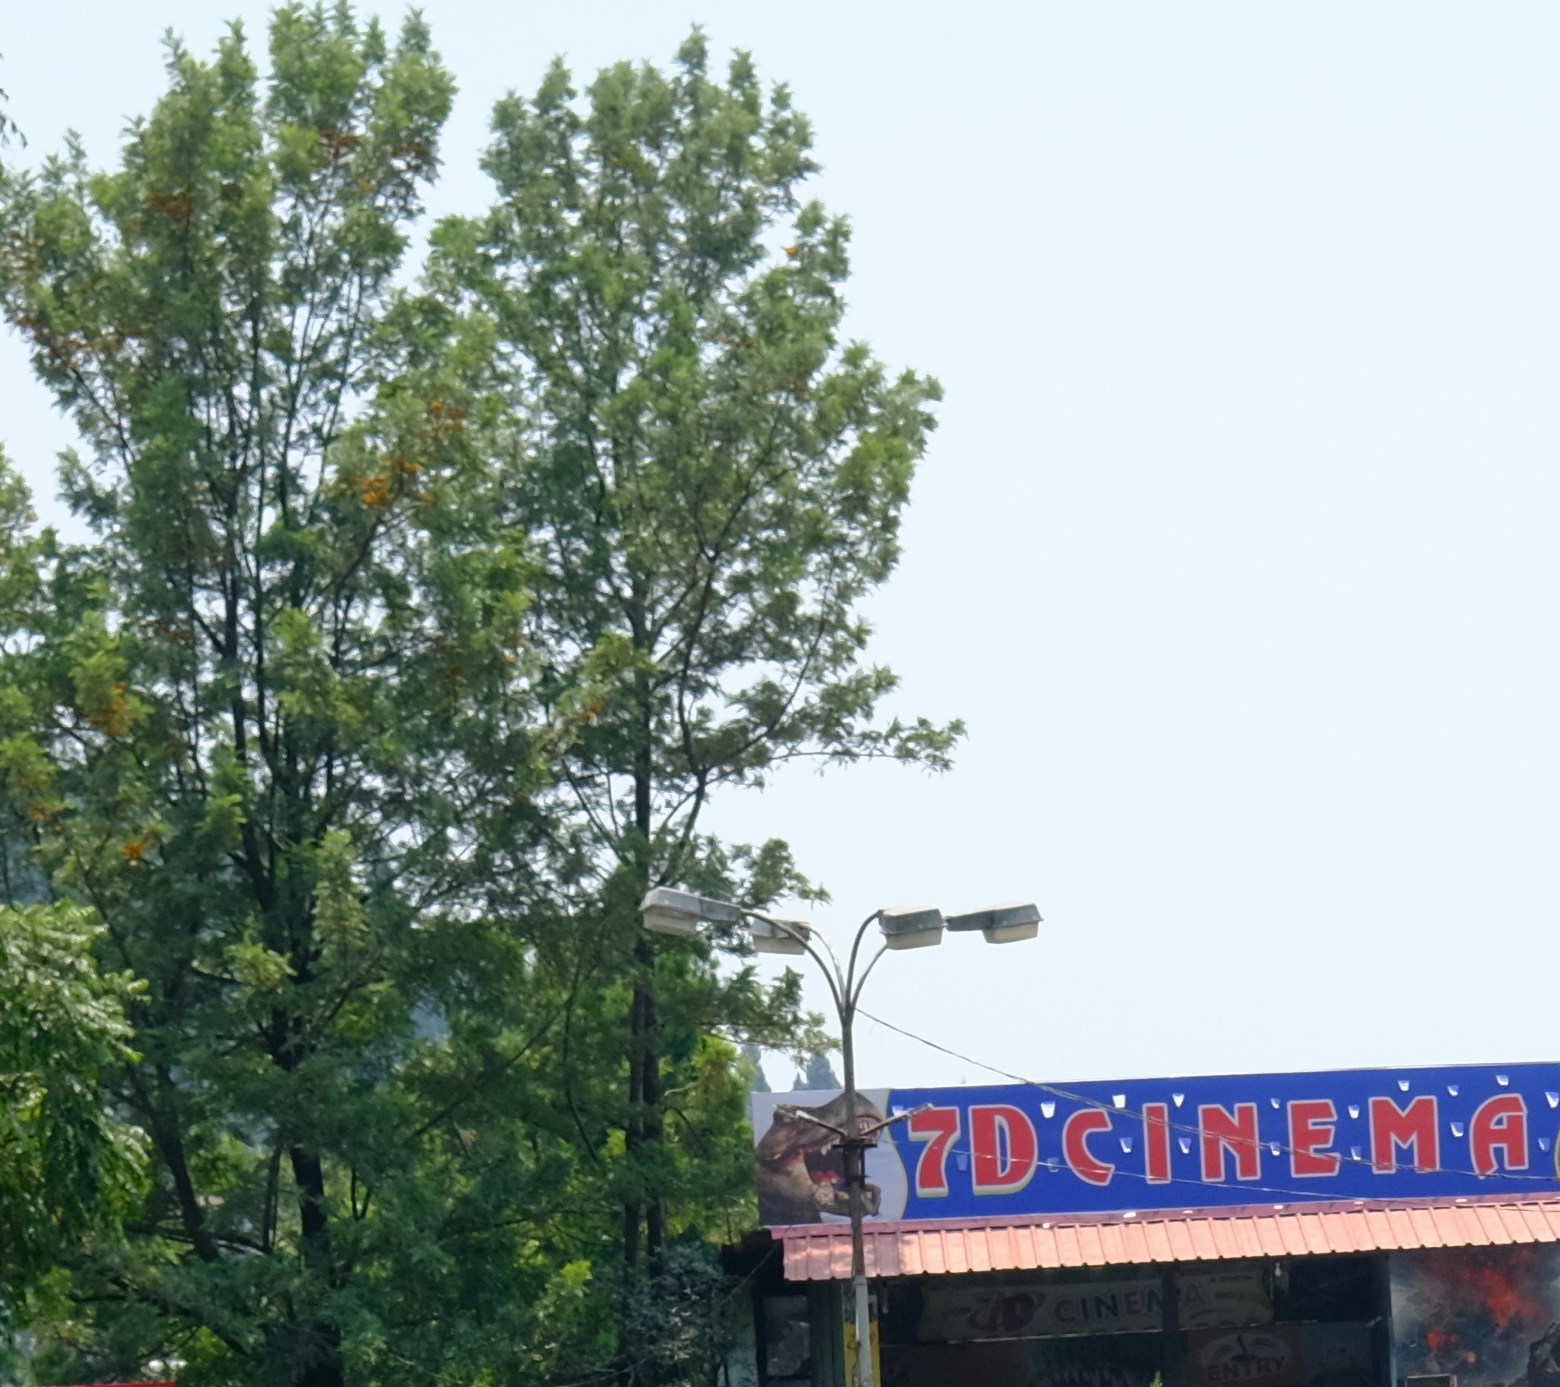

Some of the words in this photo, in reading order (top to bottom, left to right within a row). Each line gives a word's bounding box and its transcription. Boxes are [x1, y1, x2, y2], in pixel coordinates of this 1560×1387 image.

[907, 1104, 1038, 1198] 7D
[1062, 1094, 1528, 1186] CINEMA
[1208, 1354, 1286, 1383] ENTRY
